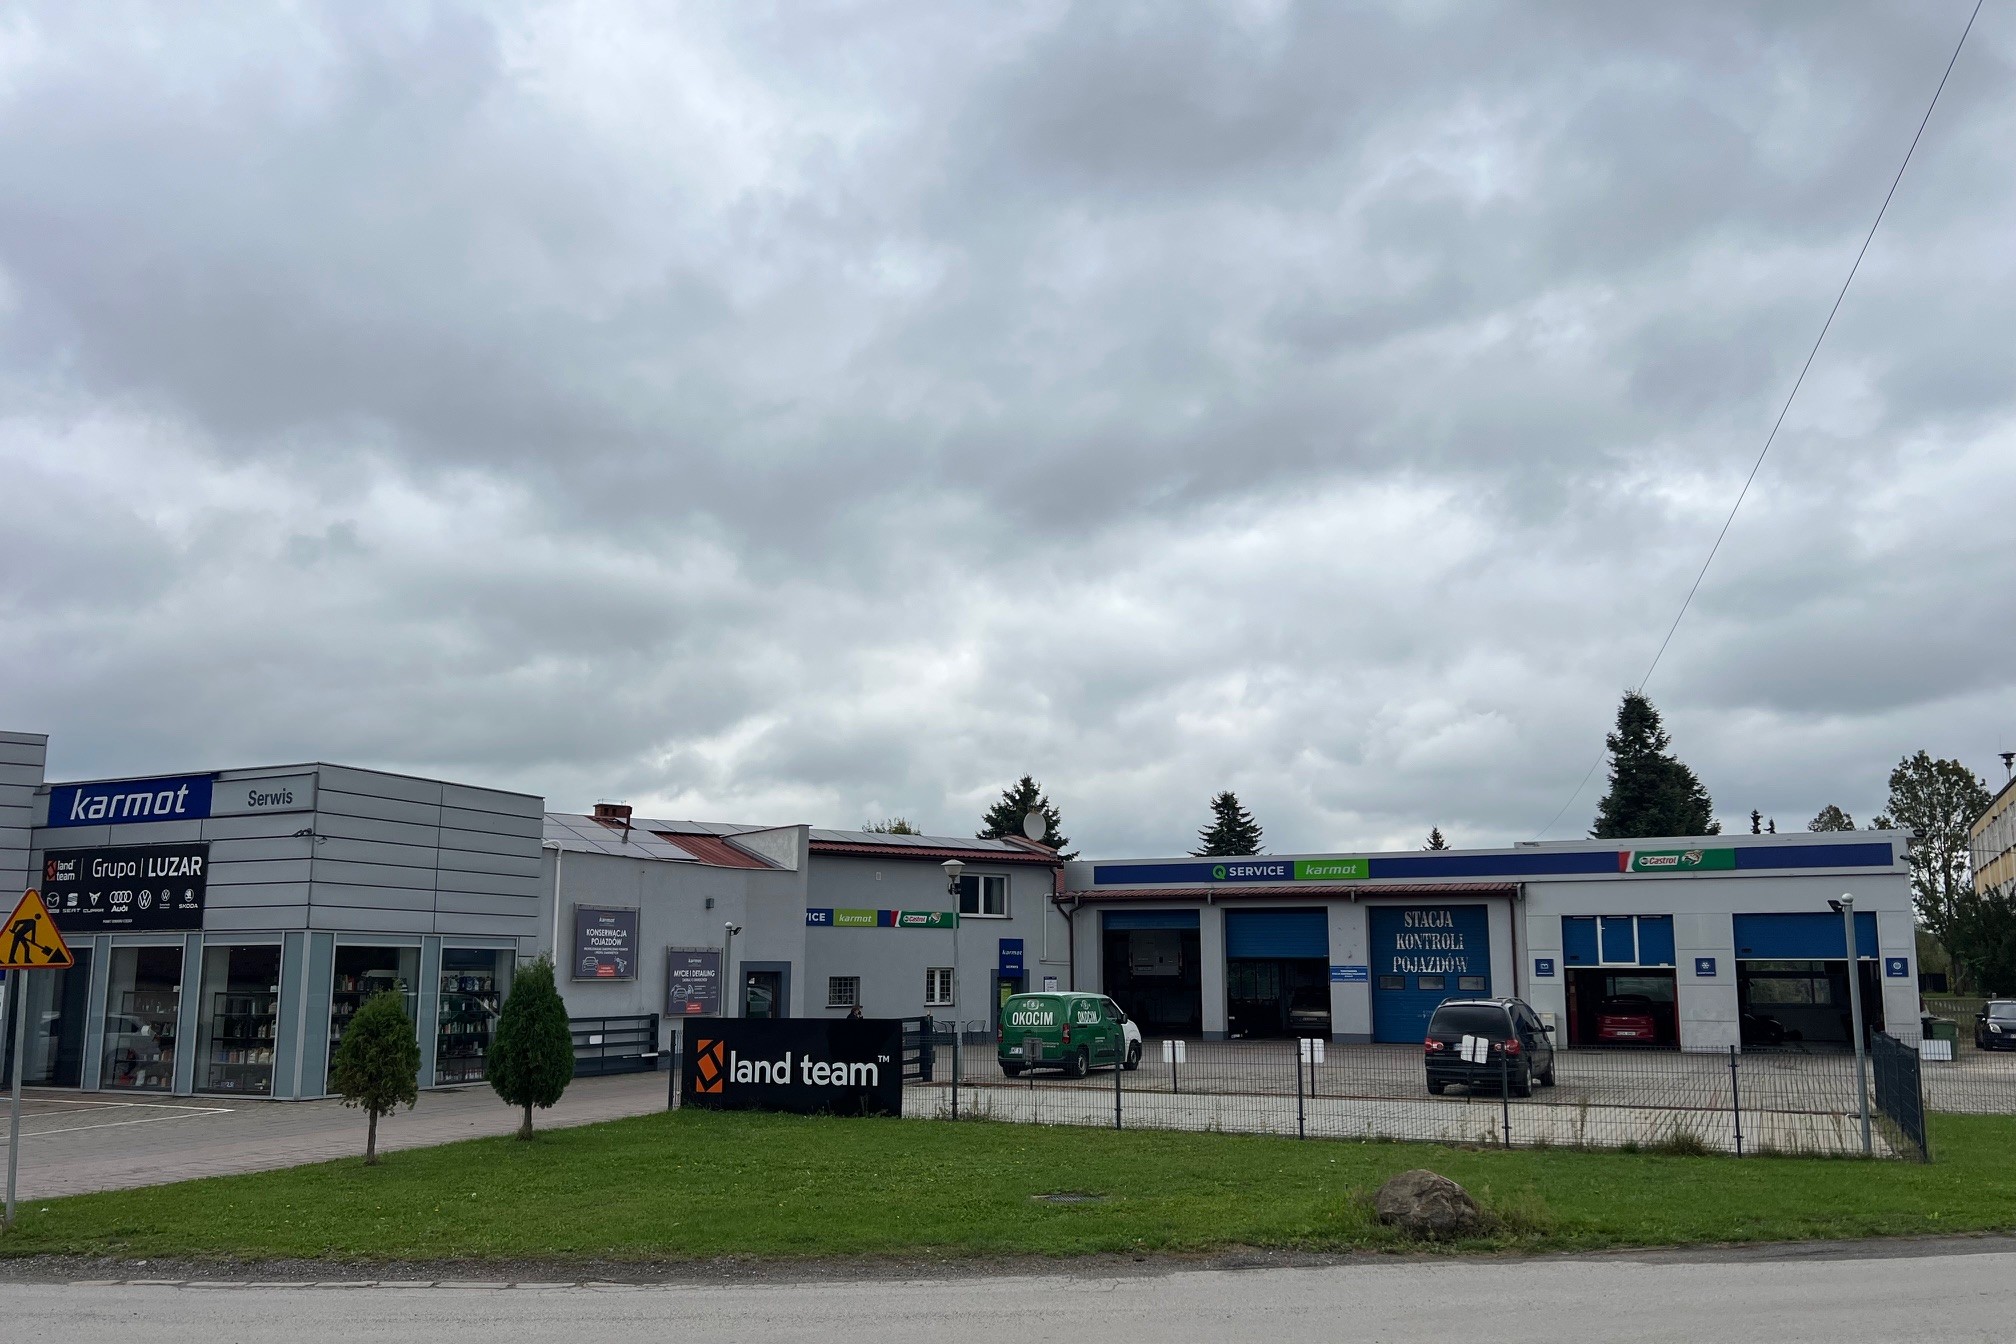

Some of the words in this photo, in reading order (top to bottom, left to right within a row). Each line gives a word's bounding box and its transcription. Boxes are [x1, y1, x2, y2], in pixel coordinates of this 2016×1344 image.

[70, 784, 189, 820] karmot
[248, 788, 293, 807] Serwis
[57, 860, 74, 870] land
[92, 858, 136, 879] Grupa
[148, 856, 203, 877] LUZAR
[1306, 864, 1357, 875] karmot
[56, 872, 75, 881] team
[1229, 866, 1285, 876] SERVICE
[110, 904, 129, 913] Audi
[839, 914, 872, 923] karmot
[1404, 910, 1454, 928] STACJA
[586, 929, 627, 937] KONSERWACJA
[591, 937, 622, 945] POJAZDÓW
[1396, 933, 1465, 950] KONTROLI
[1392, 953, 1469, 973] POJAZDÓW
[1012, 1011, 1053, 1026] OKOCIM
[1077, 1011, 1098, 1022] OKOCIM
[729, 1050, 791, 1084] land
[800, 1054, 879, 1087] team
